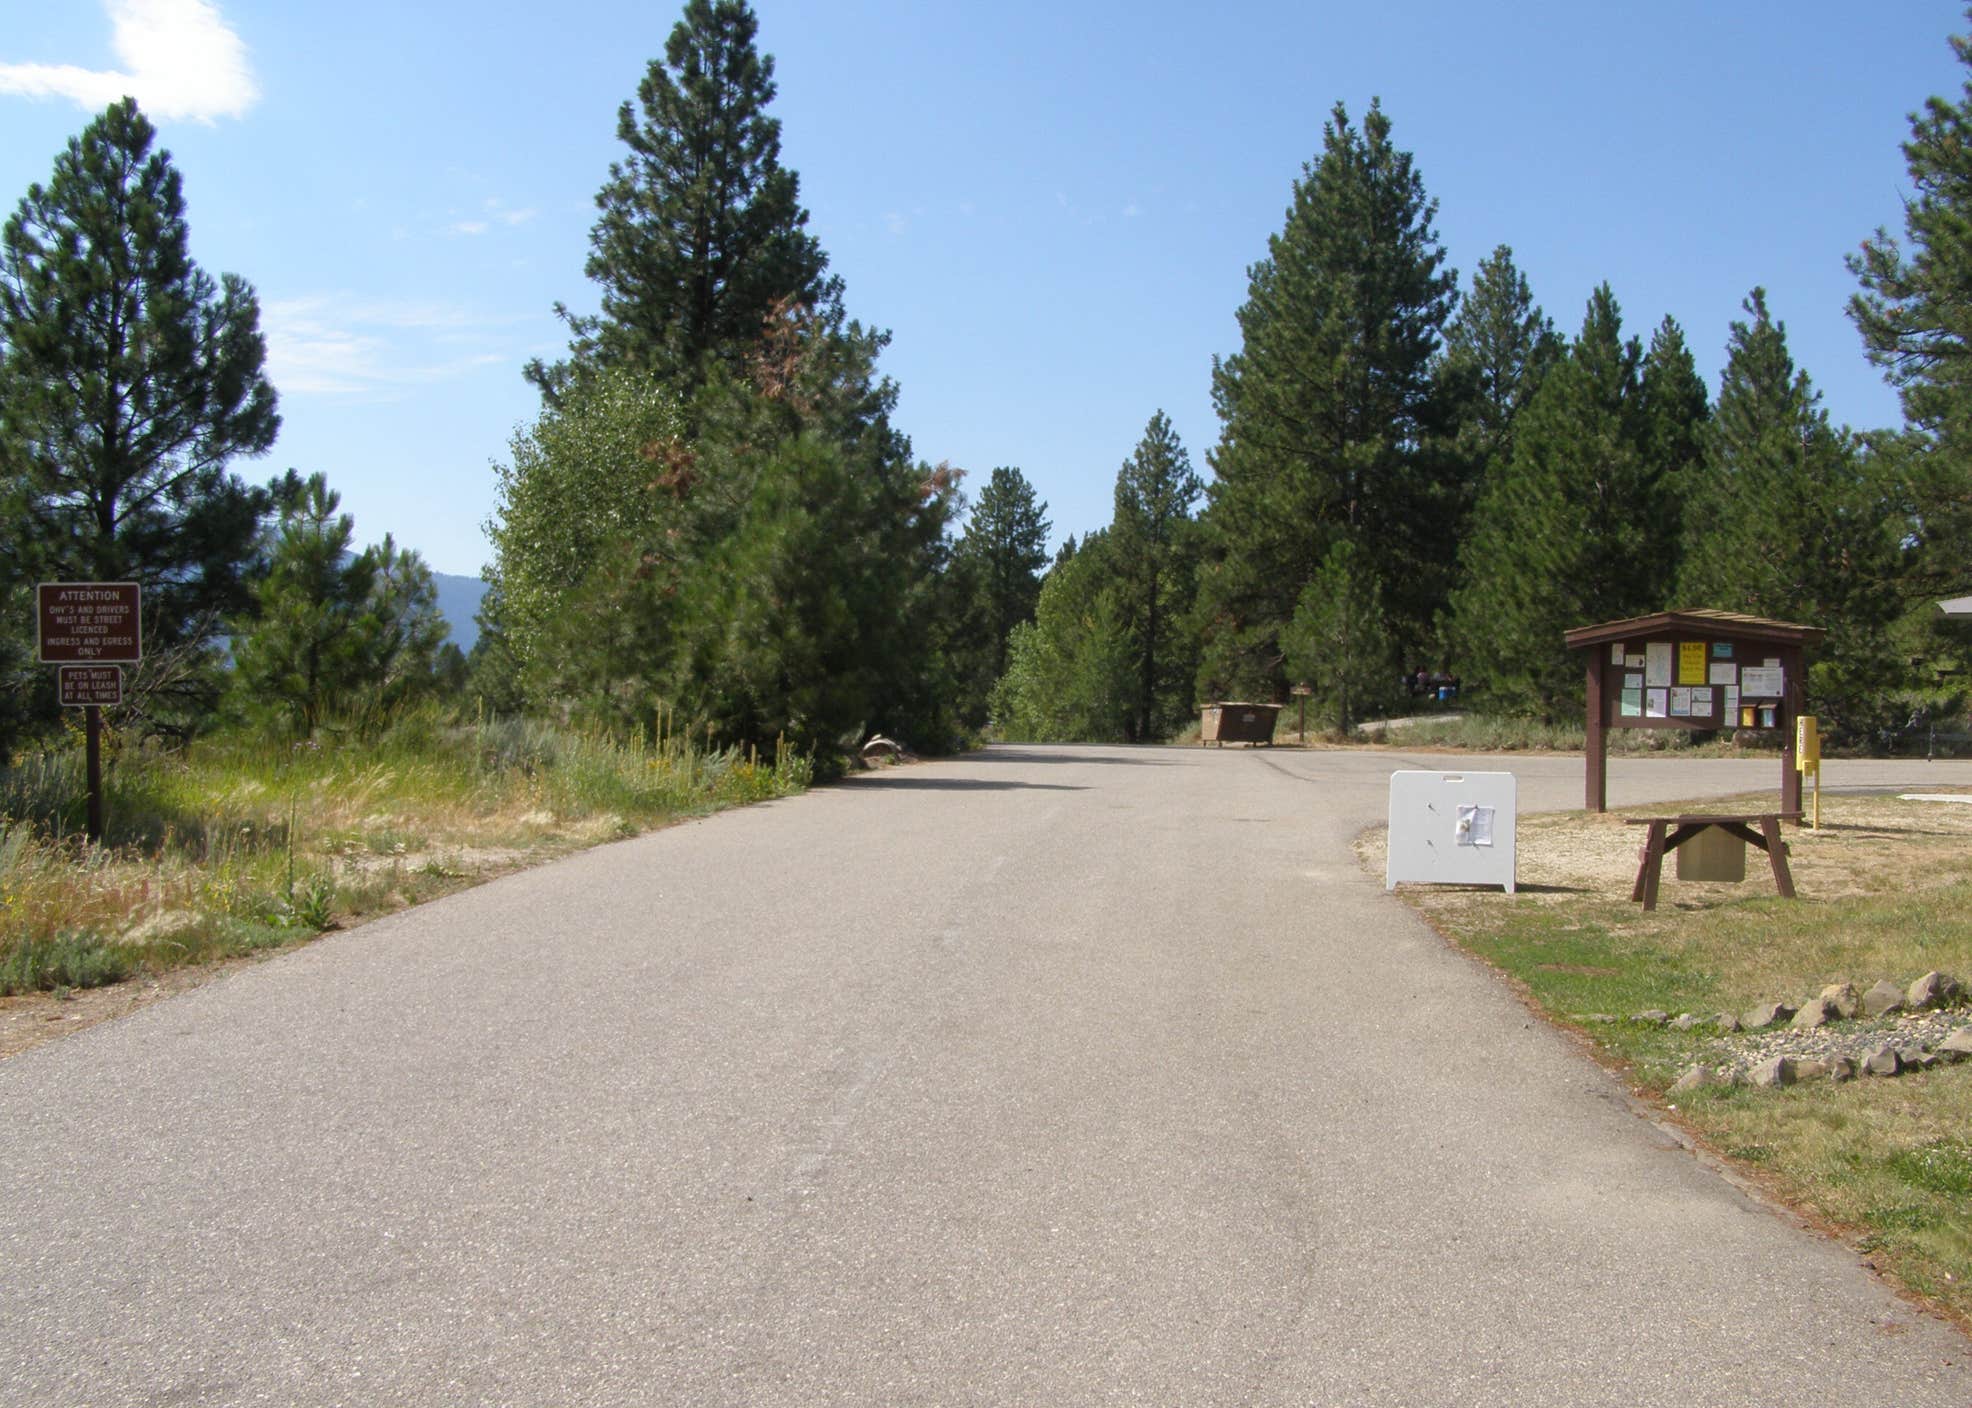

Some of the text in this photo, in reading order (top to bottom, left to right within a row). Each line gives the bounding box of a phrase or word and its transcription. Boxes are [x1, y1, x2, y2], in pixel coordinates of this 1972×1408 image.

[59, 591, 119, 600] ATTENTION
[57, 616, 77, 624] MUST
[48, 637, 132, 645] INGRESS AND EGRESS
[65, 681, 116, 690] BE ON LEASH
[64, 691, 73, 699] AT
[77, 691, 90, 699] ALL
